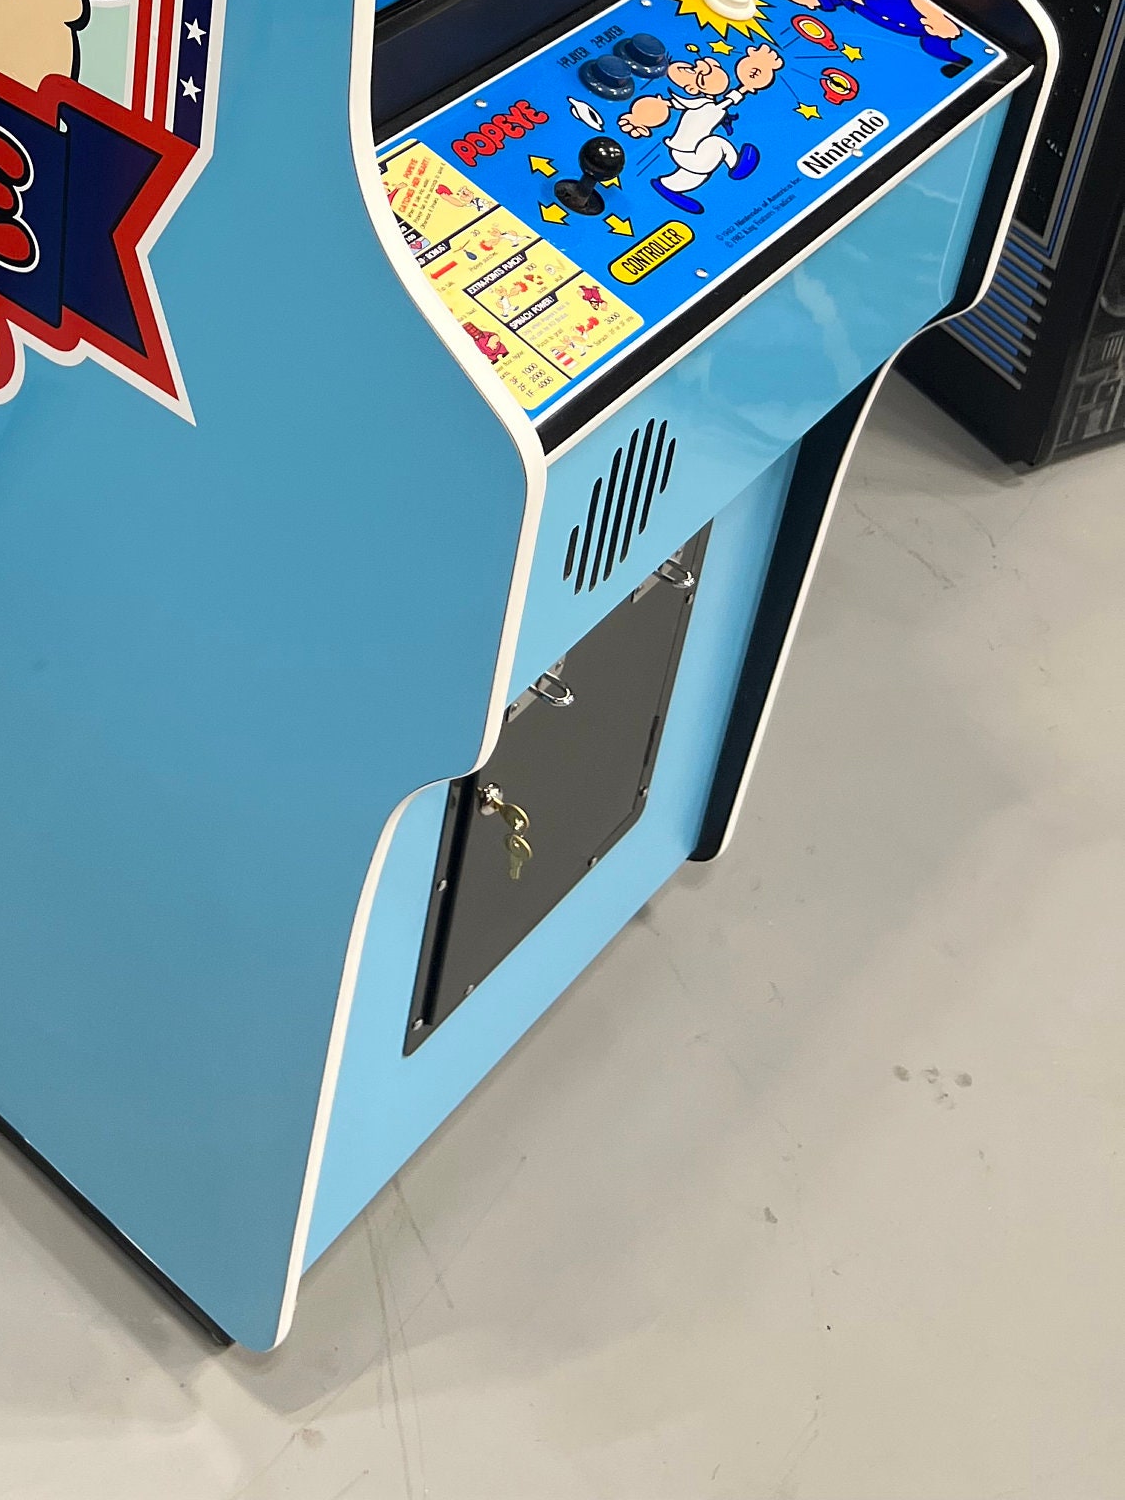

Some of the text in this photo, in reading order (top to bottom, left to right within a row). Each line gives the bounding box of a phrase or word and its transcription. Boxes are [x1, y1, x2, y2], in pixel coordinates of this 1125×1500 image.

[451, 100, 550, 166] POPEYE
[802, 114, 884, 175] Nintendo
[621, 228, 685, 276] CONTROLLER
[509, 308, 535, 330] SPINACH
[522, 362, 538, 376] 1000
[529, 369, 546, 383] 2000
[538, 376, 554, 389] 4000
